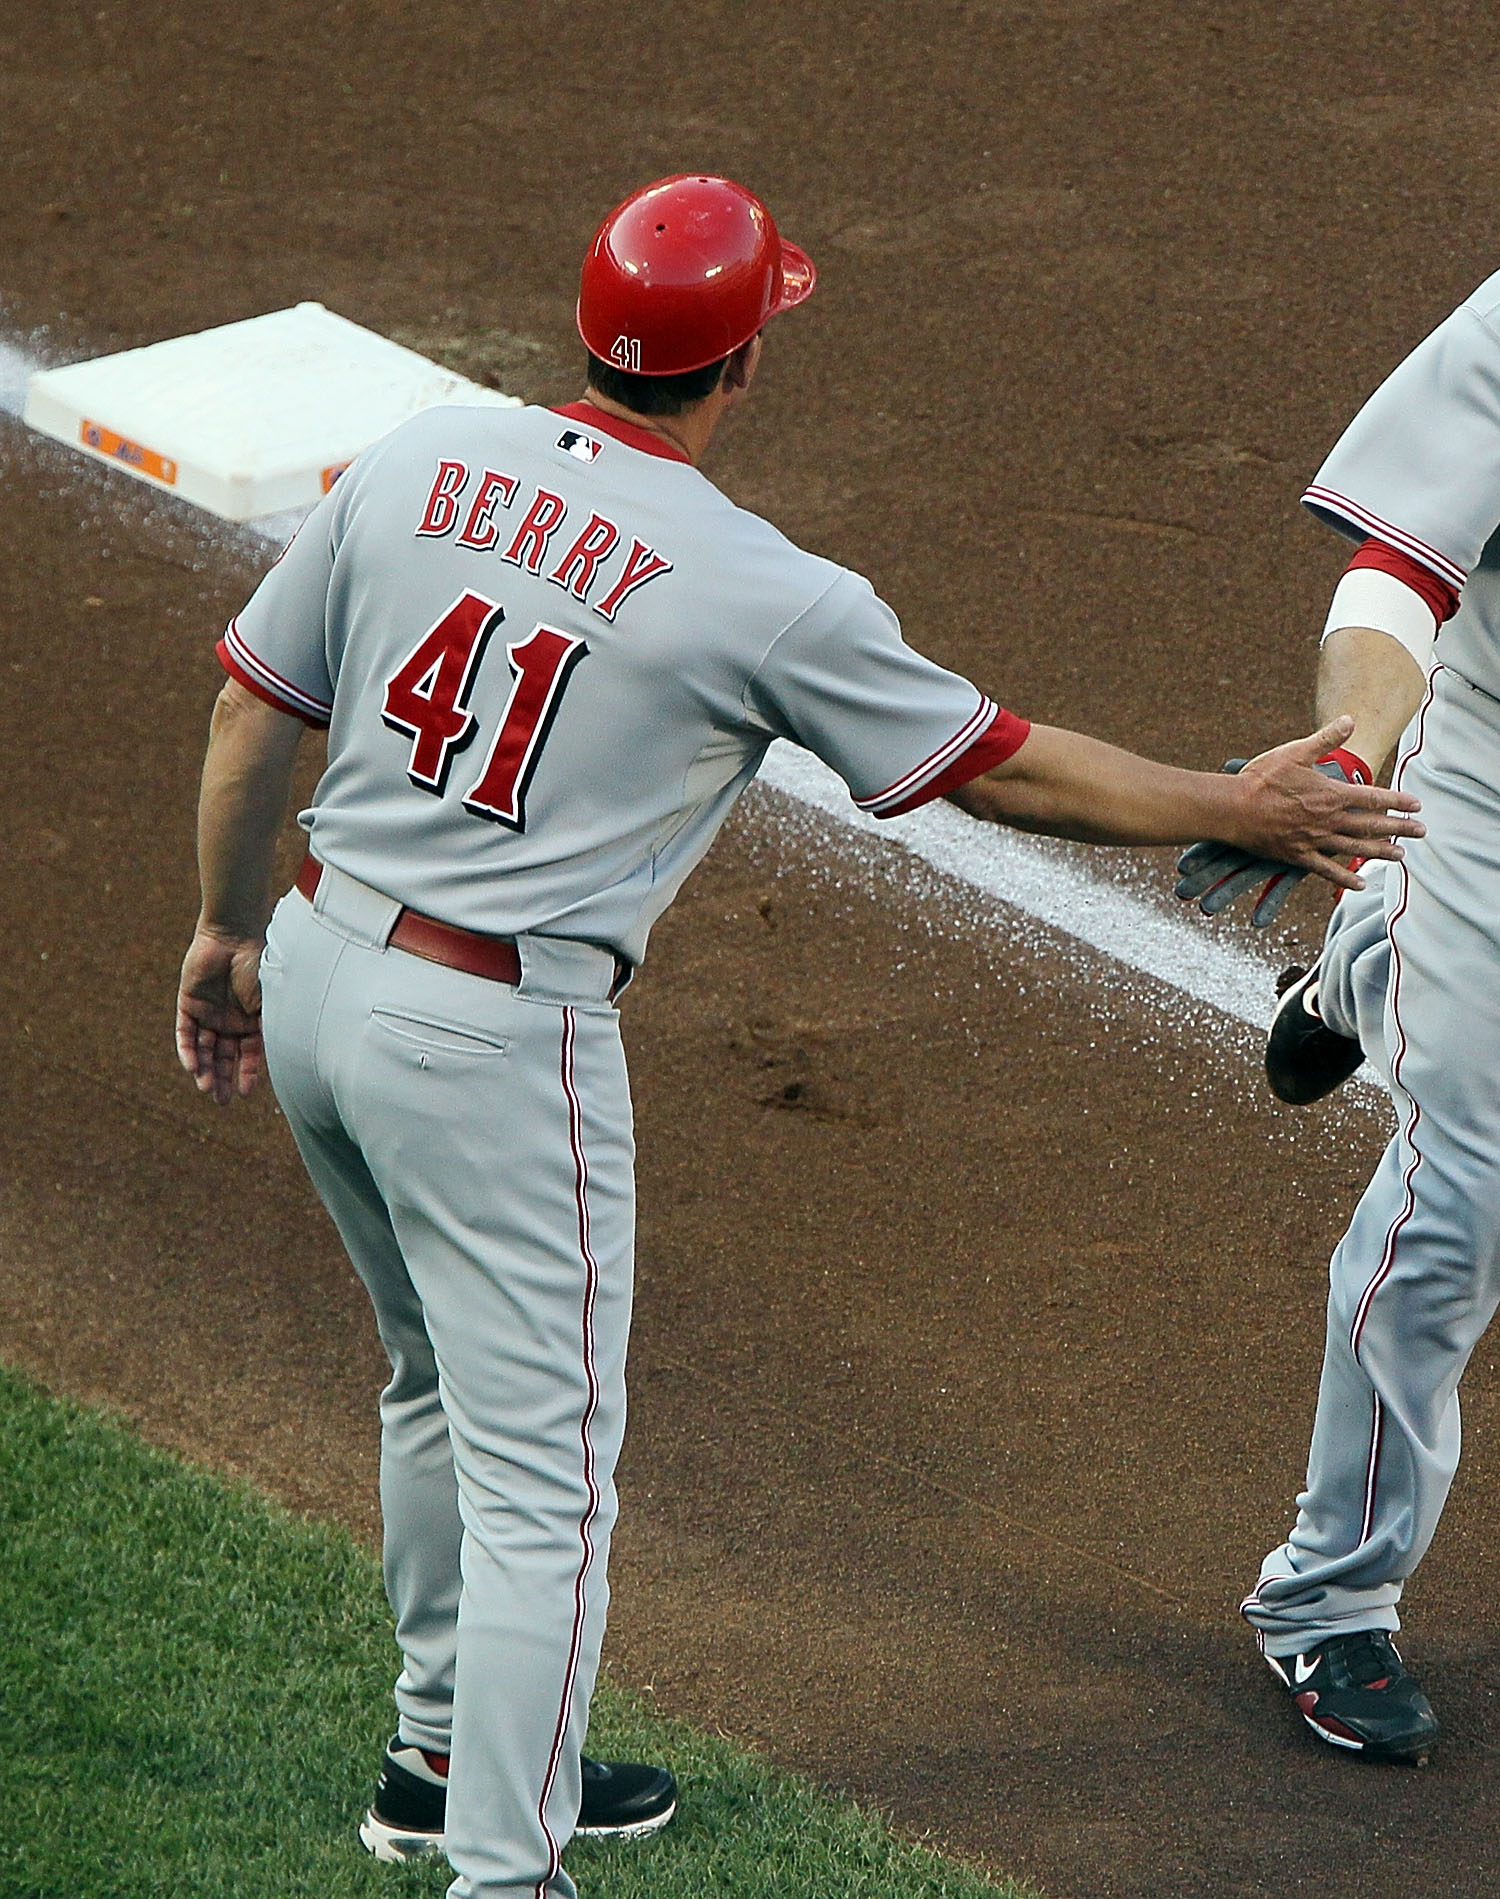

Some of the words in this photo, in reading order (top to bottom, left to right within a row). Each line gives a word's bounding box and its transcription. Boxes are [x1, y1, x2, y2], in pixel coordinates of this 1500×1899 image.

[610, 335, 641, 371] 41
[415, 458, 673, 622] BERRY
[380, 588, 590, 834] 41
